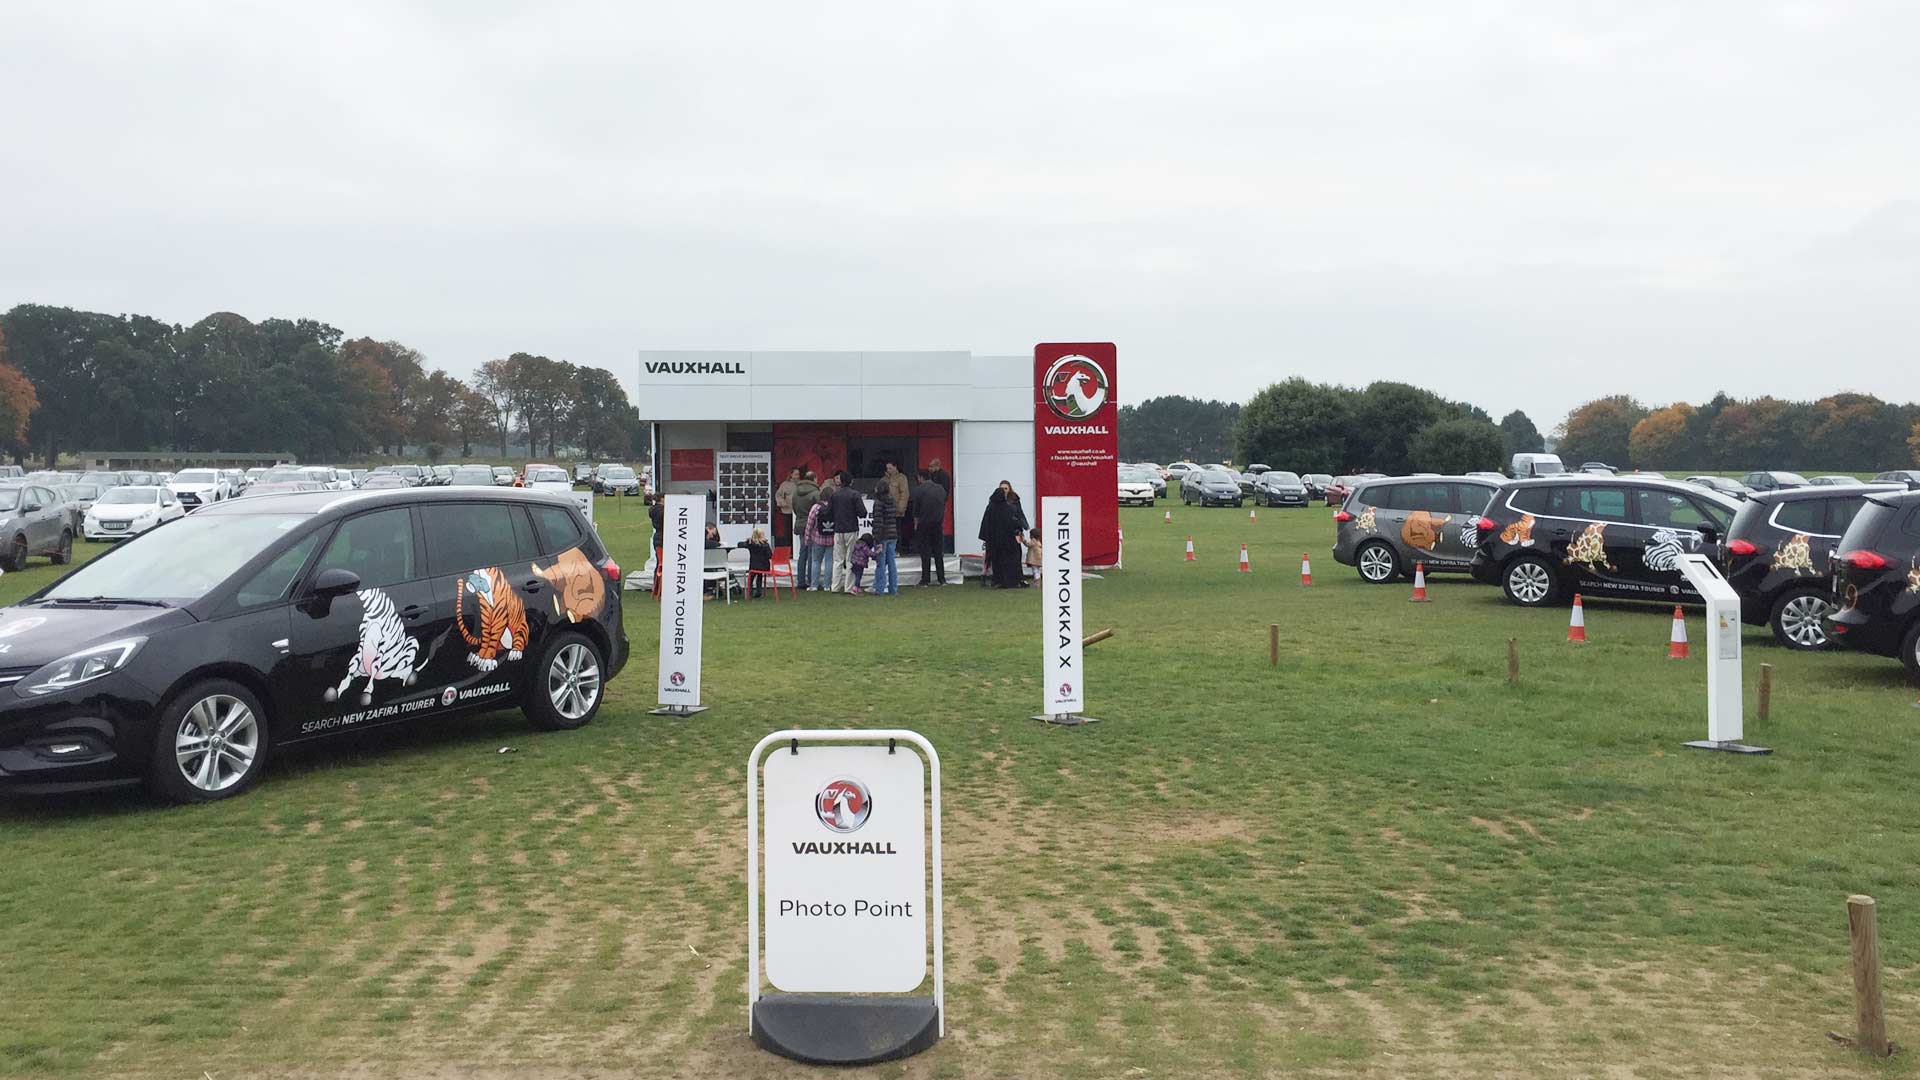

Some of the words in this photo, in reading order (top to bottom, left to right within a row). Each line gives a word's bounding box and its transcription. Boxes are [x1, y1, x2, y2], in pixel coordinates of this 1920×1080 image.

[645, 362, 745, 374] VAUXHALL
[1044, 426, 1109, 435] VAUXHALL
[678, 507, 688, 540] NEW
[1057, 512, 1070, 562] NEW
[676, 543, 687, 595] ZAFIRA
[1618, 583, 1640, 591] ZAFIRA
[1640, 585, 1665, 593] TOURER
[1058, 569, 1071, 649] MOKKA
[674, 598, 685, 656] TOURER
[1059, 656, 1072, 669] X
[458, 682, 511, 700] VAUXHALL
[301, 717, 341, 734] SEARCH
[341, 711, 365, 726] NEW
[365, 704, 399, 721] ZAFIRA
[400, 698, 436, 714] TOURER
[792, 841, 897, 855] VAUXHALL
[780, 899, 847, 918] Photo
[854, 899, 913, 918] Point
